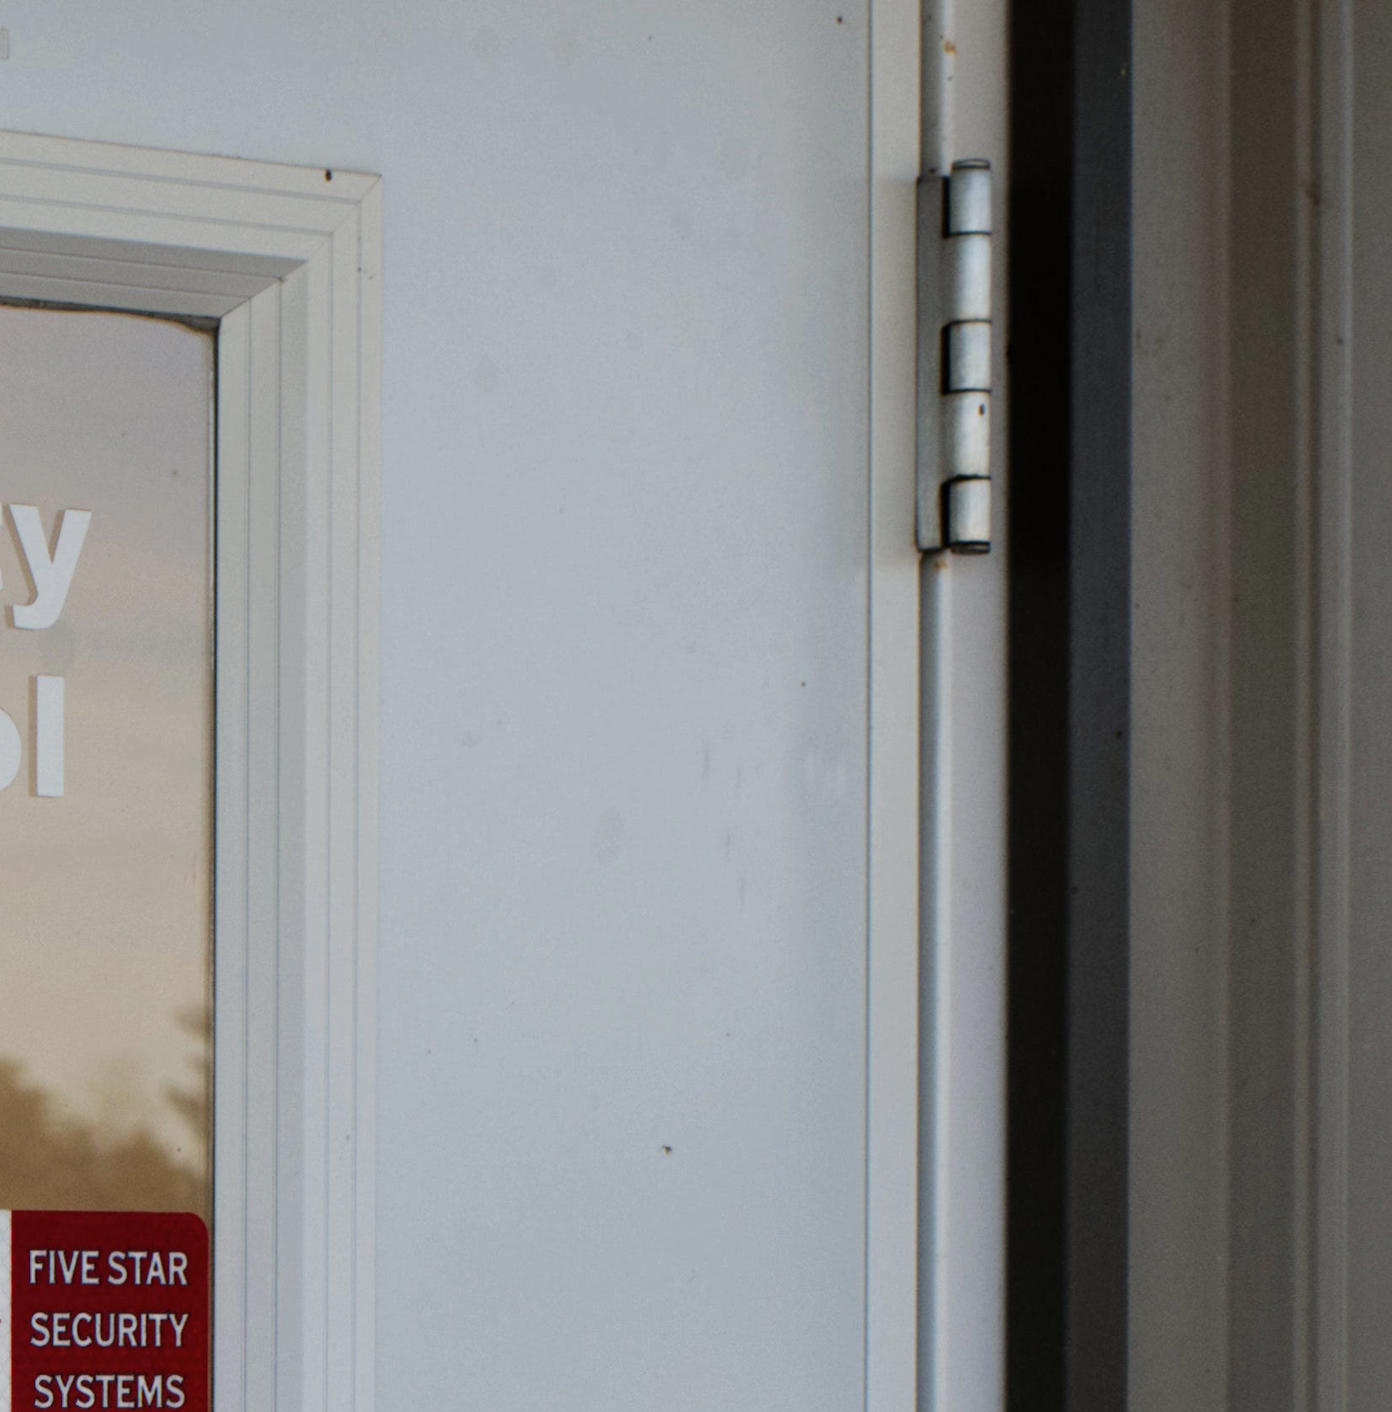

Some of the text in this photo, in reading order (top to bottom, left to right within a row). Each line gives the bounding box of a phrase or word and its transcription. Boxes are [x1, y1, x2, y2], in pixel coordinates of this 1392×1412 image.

[28, 1250, 188, 1286] FIVE STAR
[30, 1312, 189, 1348] SECURITY
[33, 1374, 185, 1409] SYSTEMS
